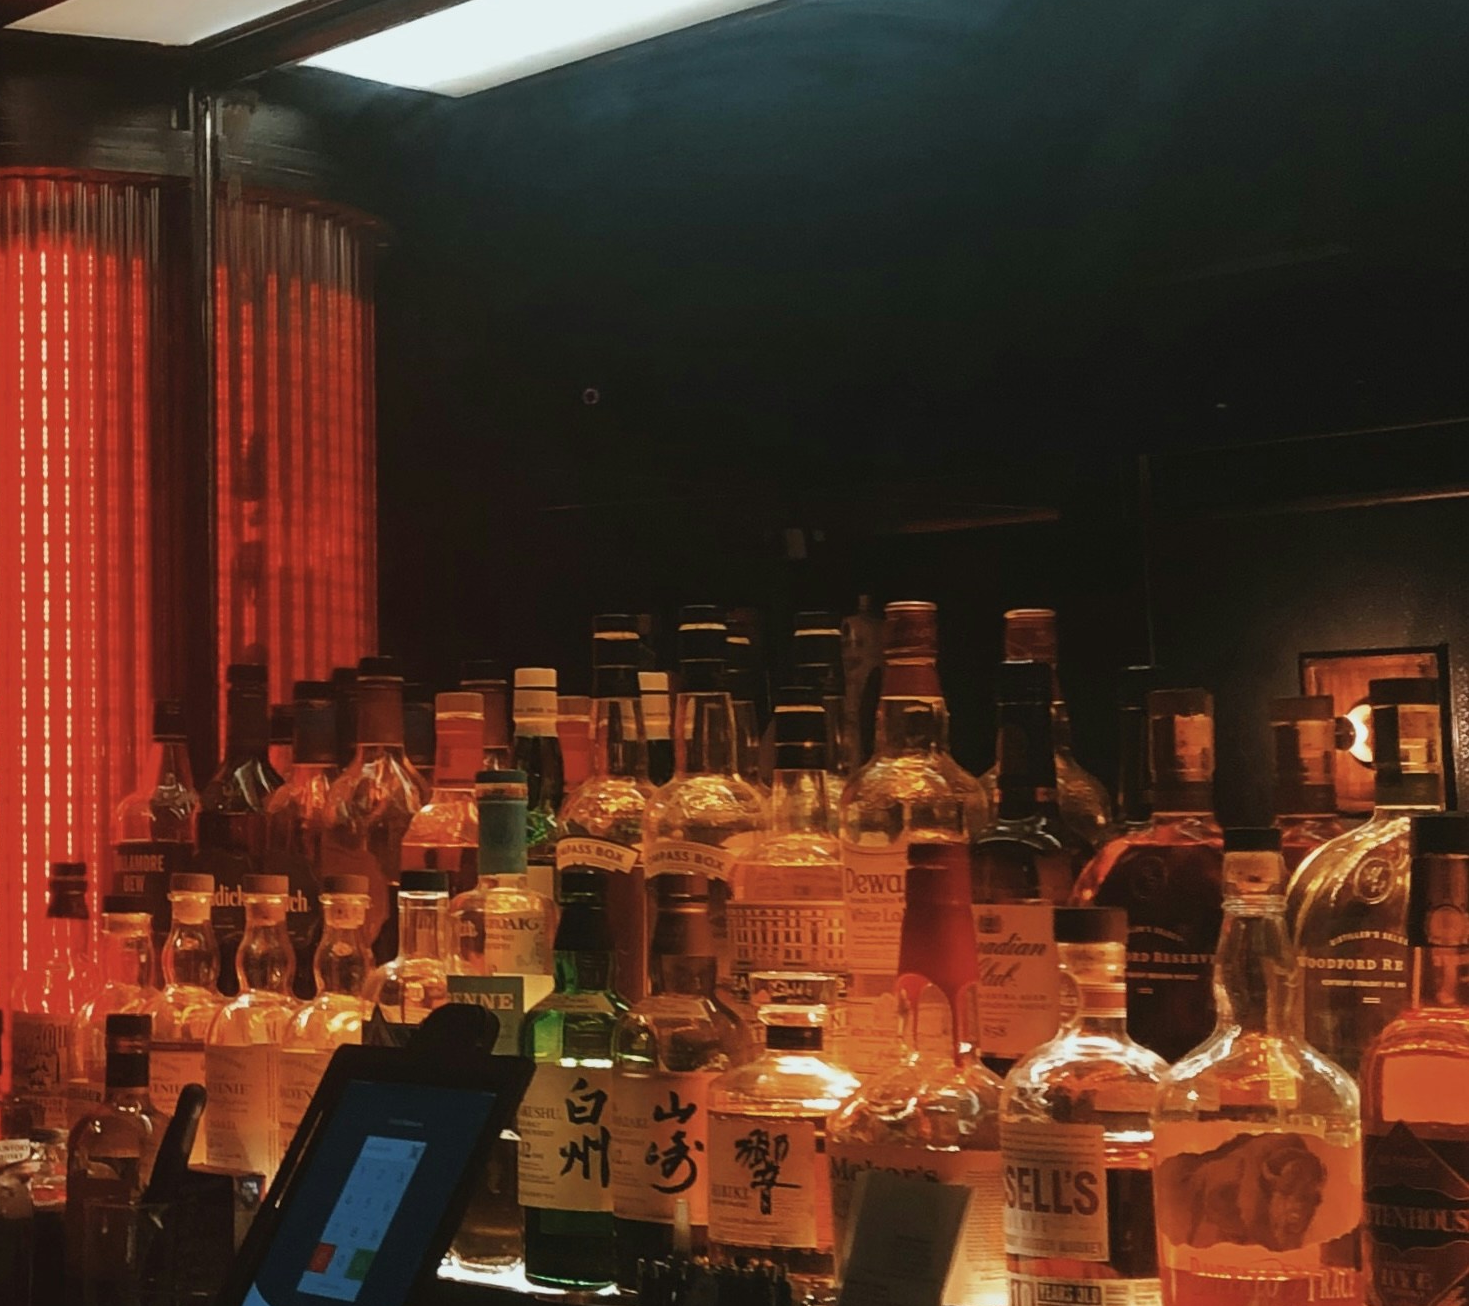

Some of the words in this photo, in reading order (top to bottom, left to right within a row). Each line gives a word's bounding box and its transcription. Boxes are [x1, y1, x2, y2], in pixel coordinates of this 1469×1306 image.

[845, 867, 904, 895] Dewa
[979, 933, 1047, 956] nadian
[1005, 1164, 1100, 1216] SELL'S
